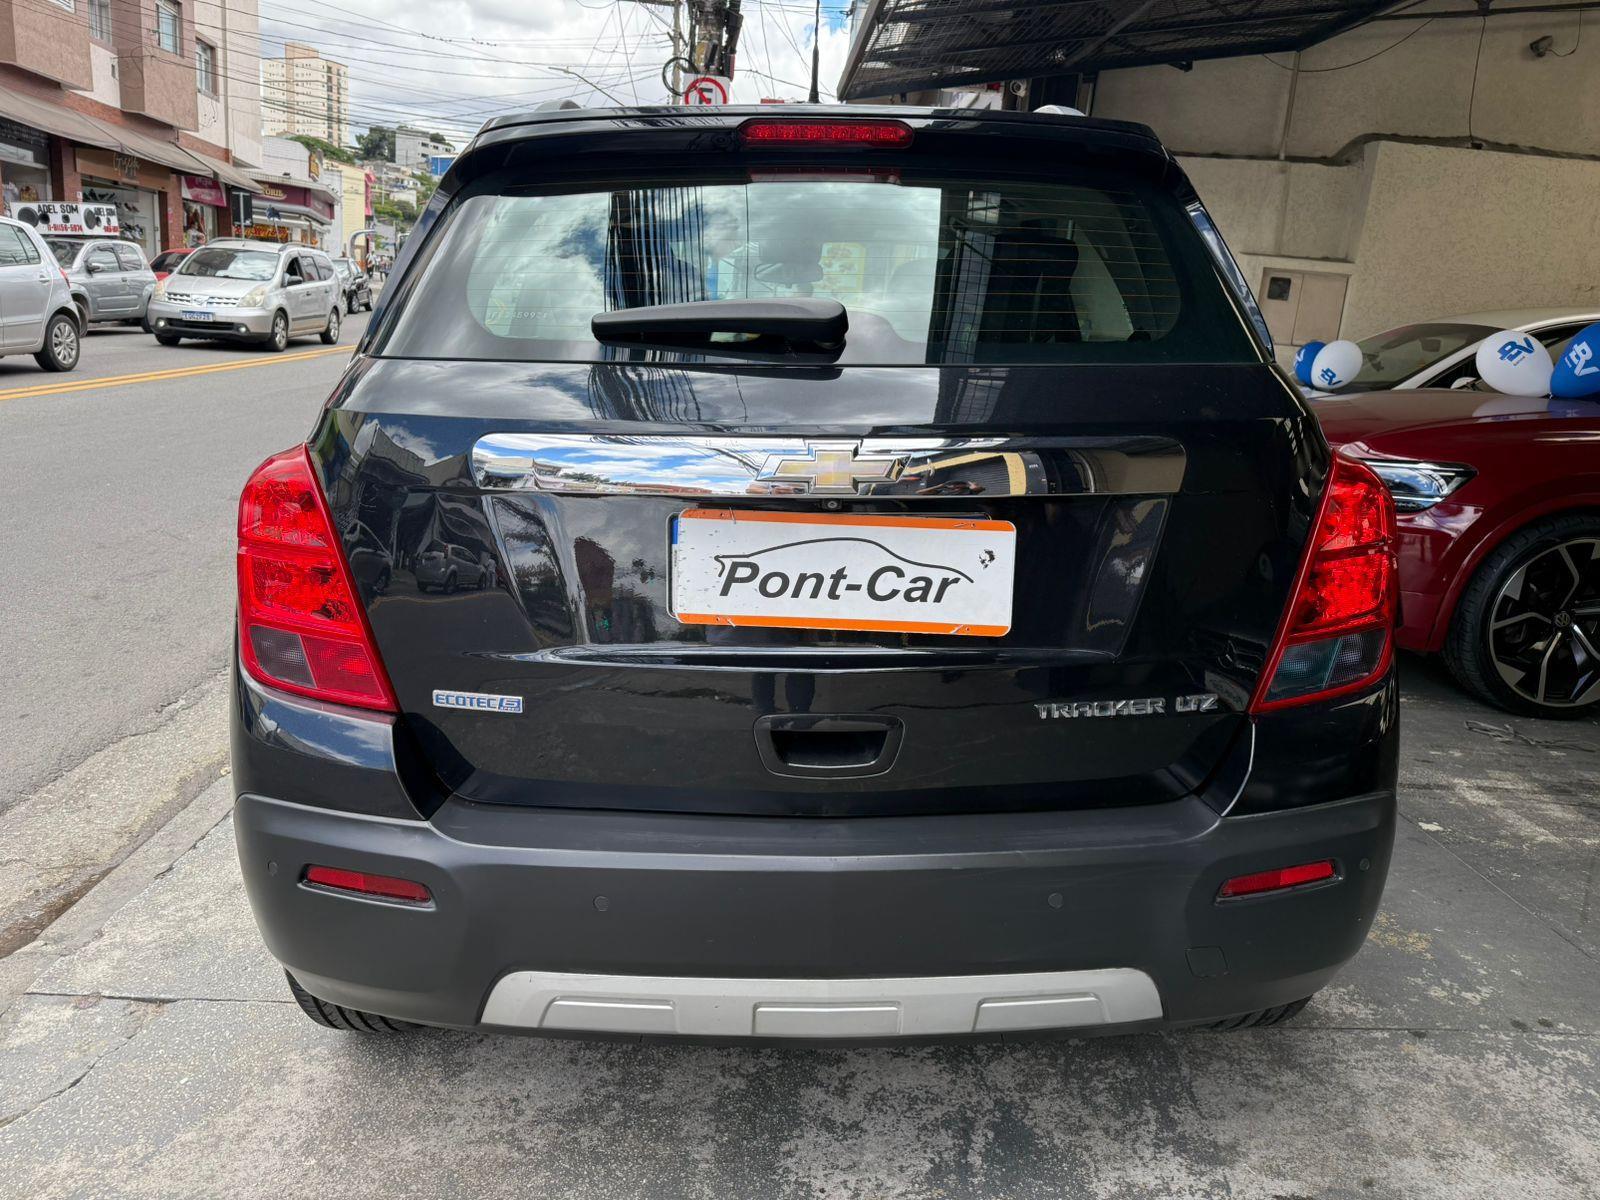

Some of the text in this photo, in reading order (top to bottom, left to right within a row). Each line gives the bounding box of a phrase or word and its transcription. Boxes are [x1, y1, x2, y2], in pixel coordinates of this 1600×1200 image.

[38, 204, 79, 214] ADEL SOM
[719, 560, 960, 604] Pont-Car
[435, 694, 497, 709] ECOTEC
[1034, 694, 1218, 719] TRACKER LTZ
